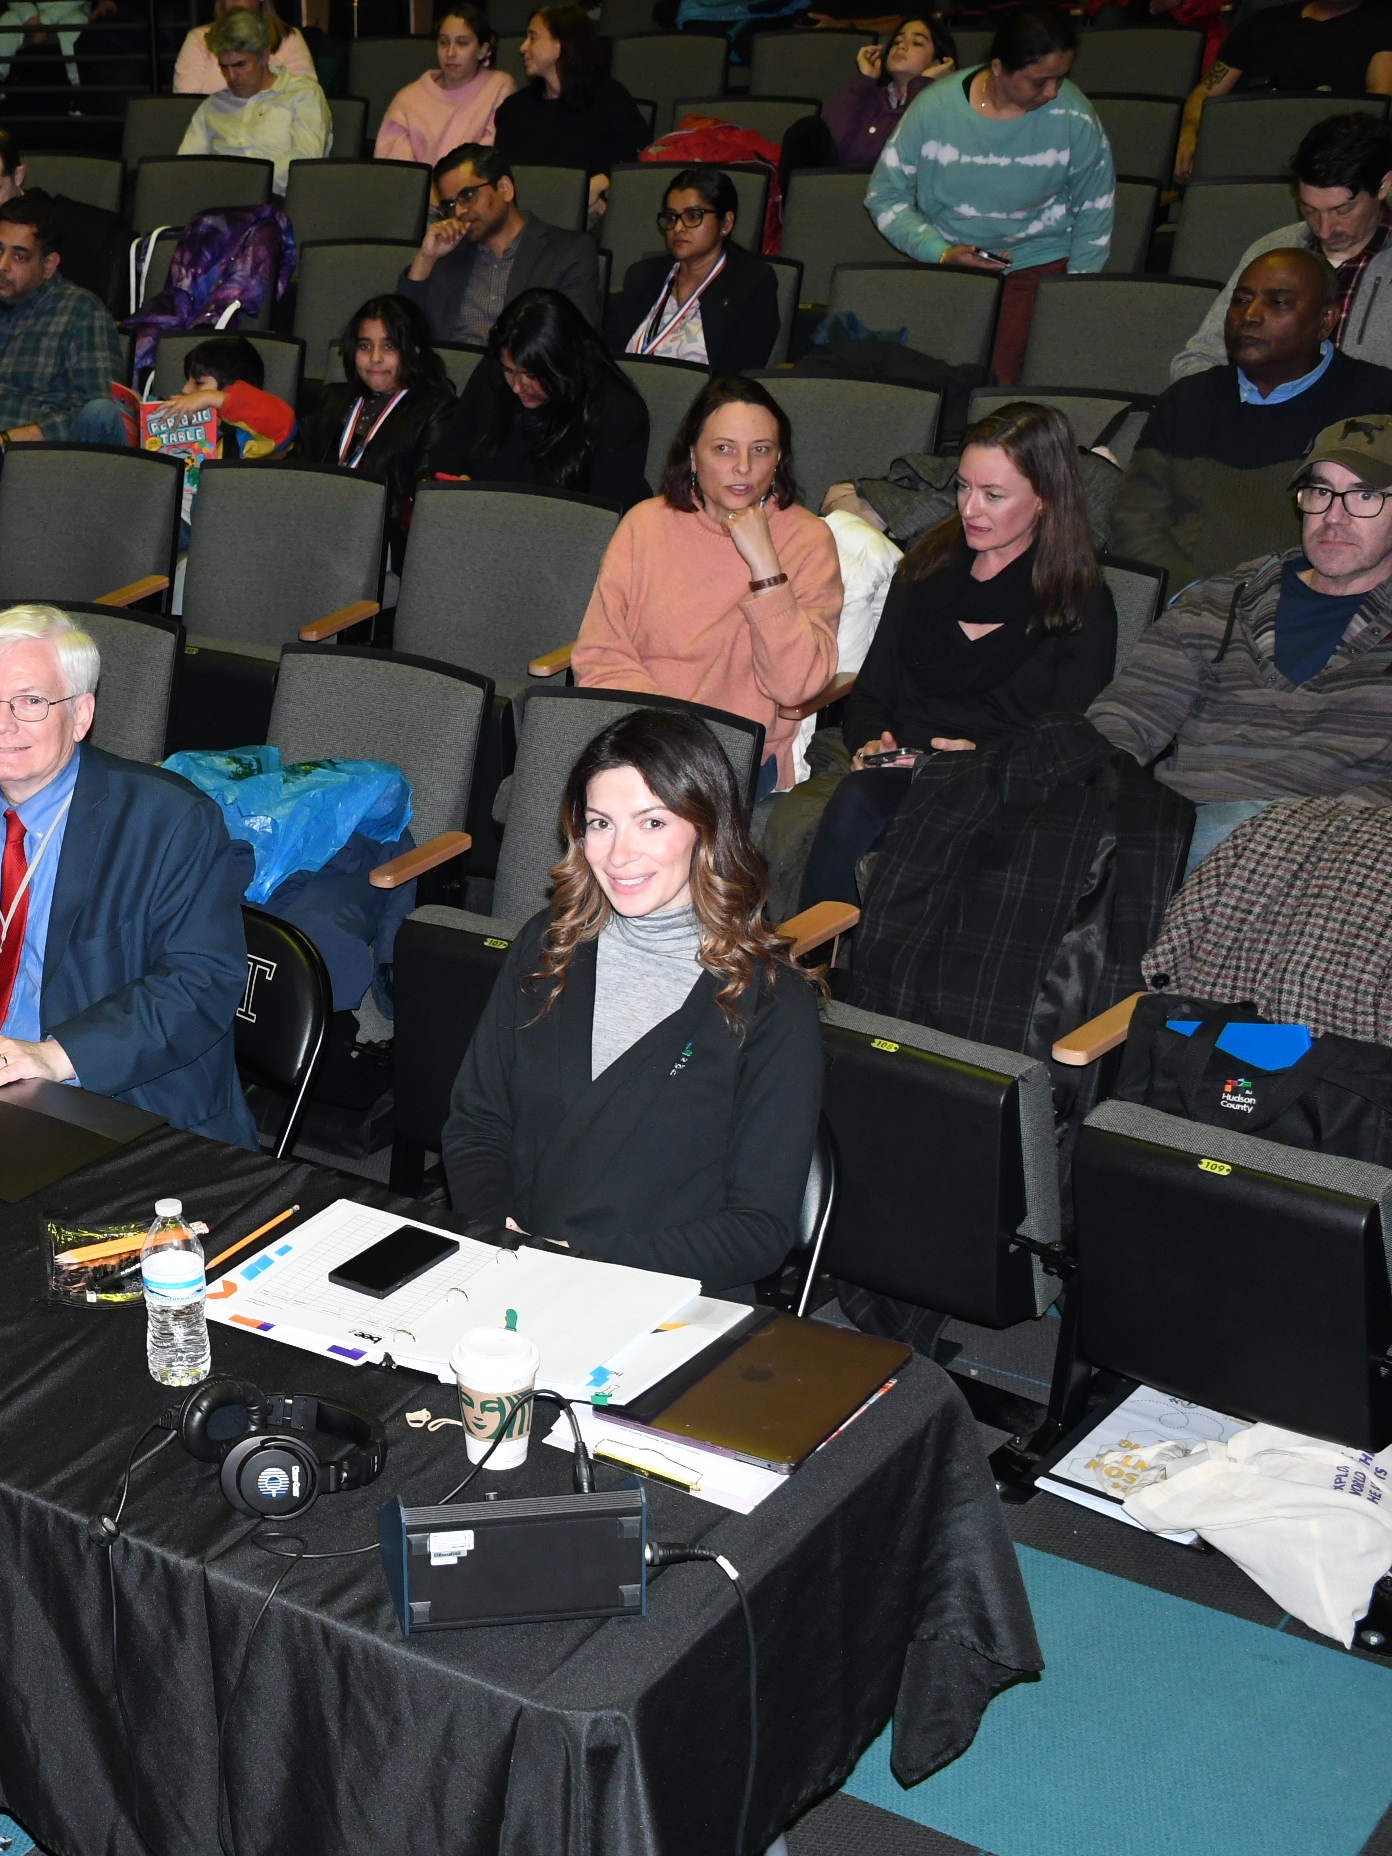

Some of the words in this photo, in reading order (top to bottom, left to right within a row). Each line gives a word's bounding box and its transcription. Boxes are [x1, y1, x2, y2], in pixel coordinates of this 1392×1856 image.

[160, 428, 204, 445] TABLE
[876, 1040, 894, 1050] 108
[1221, 1092, 1257, 1105] Hudson
[1220, 1100, 1254, 1114] County
[1205, 1161, 1225, 1172] 109
